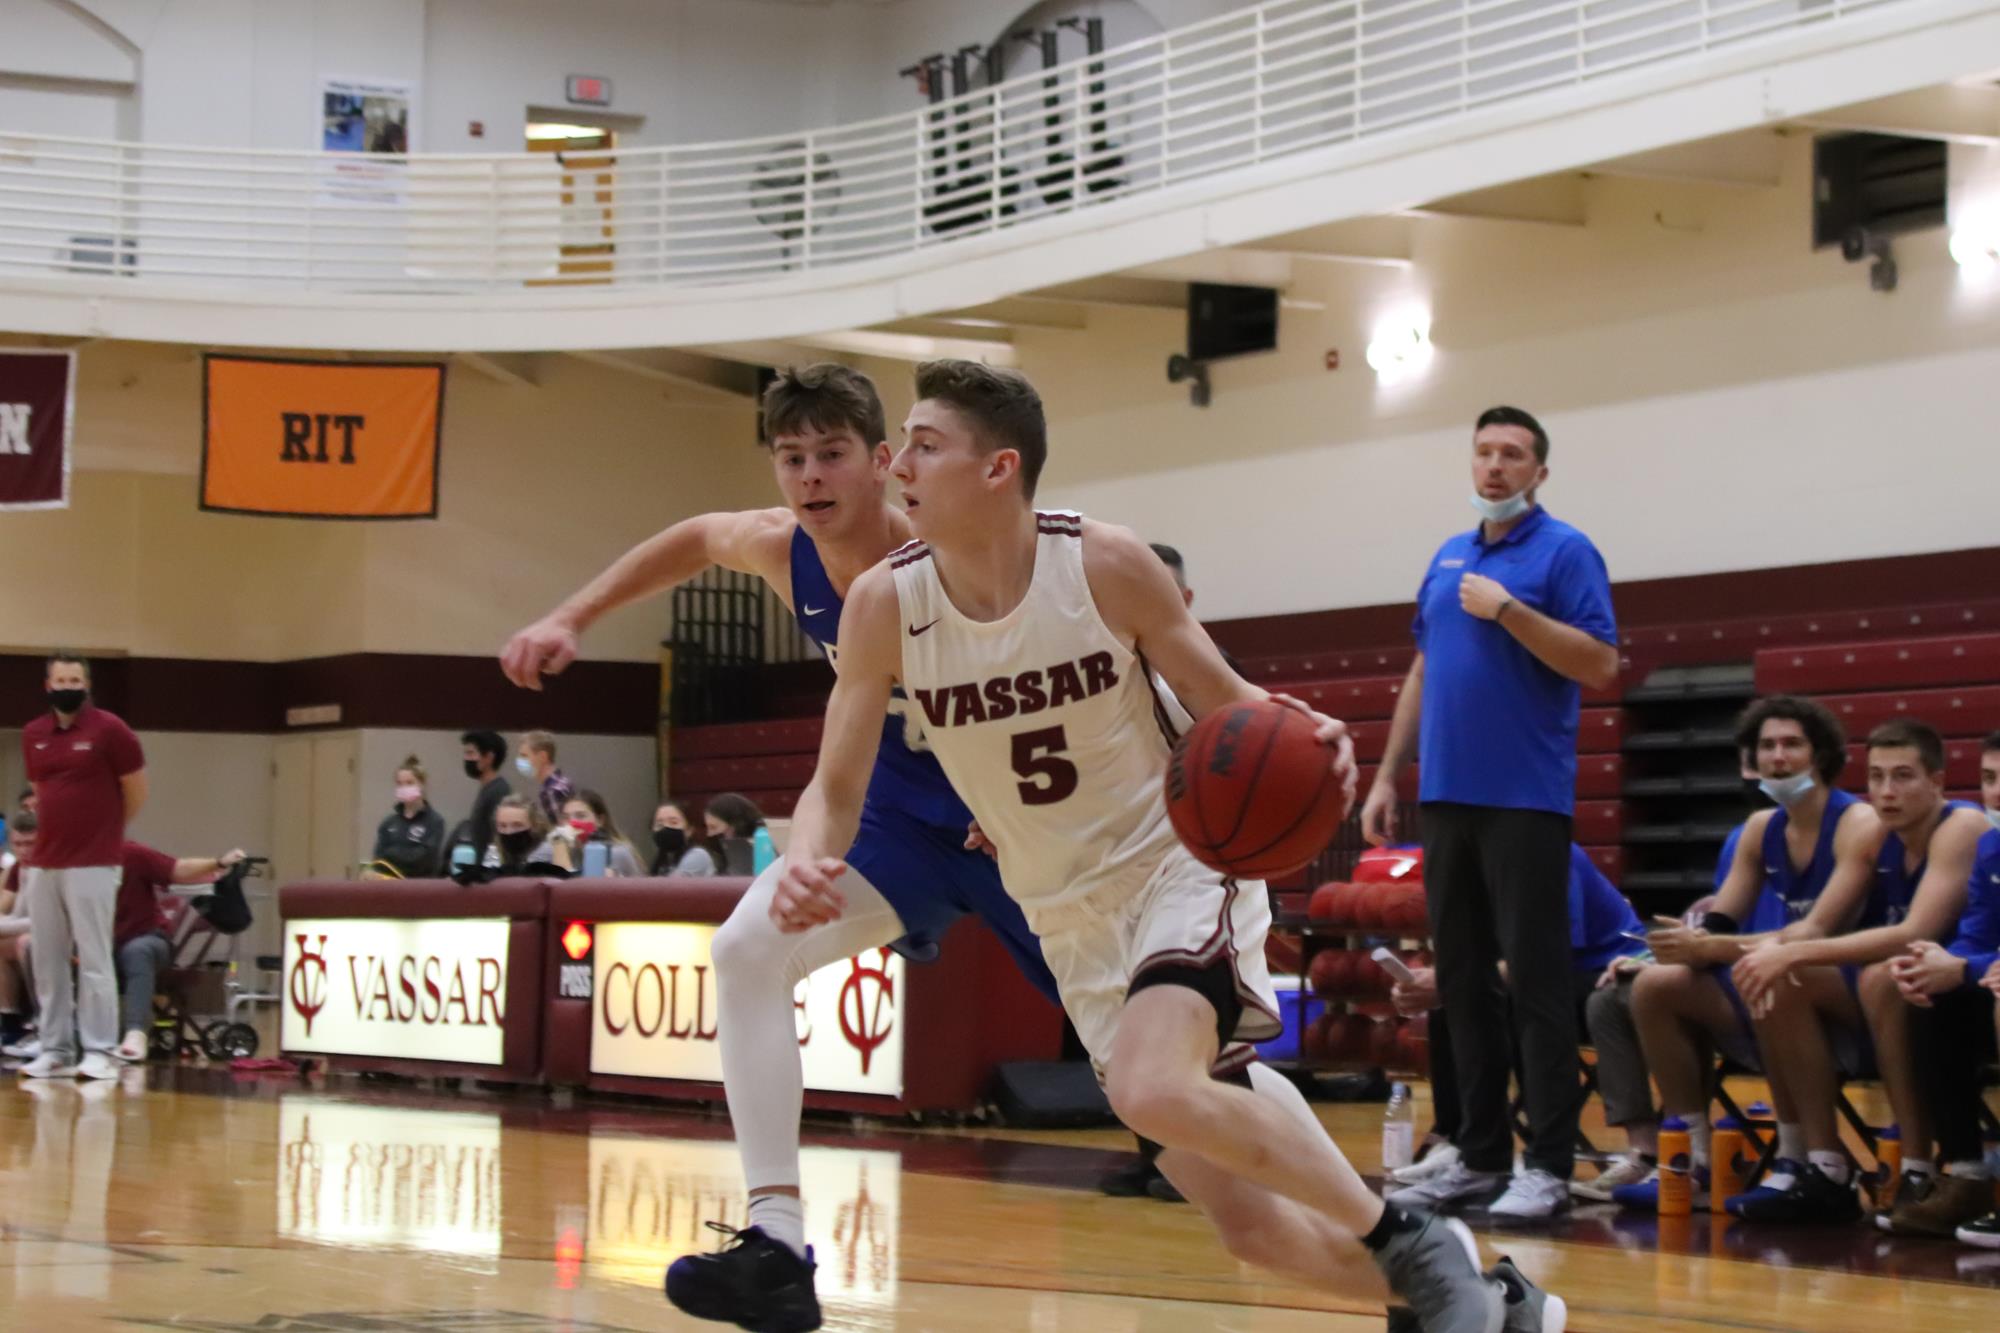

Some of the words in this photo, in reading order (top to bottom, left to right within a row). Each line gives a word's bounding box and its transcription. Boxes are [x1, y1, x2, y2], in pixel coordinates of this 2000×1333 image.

[280, 412, 364, 464] RIT
[914, 650, 1120, 728] VASSAR
[1010, 724, 1078, 805] 5
[347, 954, 504, 1030] VASSAR
[560, 963, 592, 998] POSS
[602, 961, 812, 1047] COLLE
